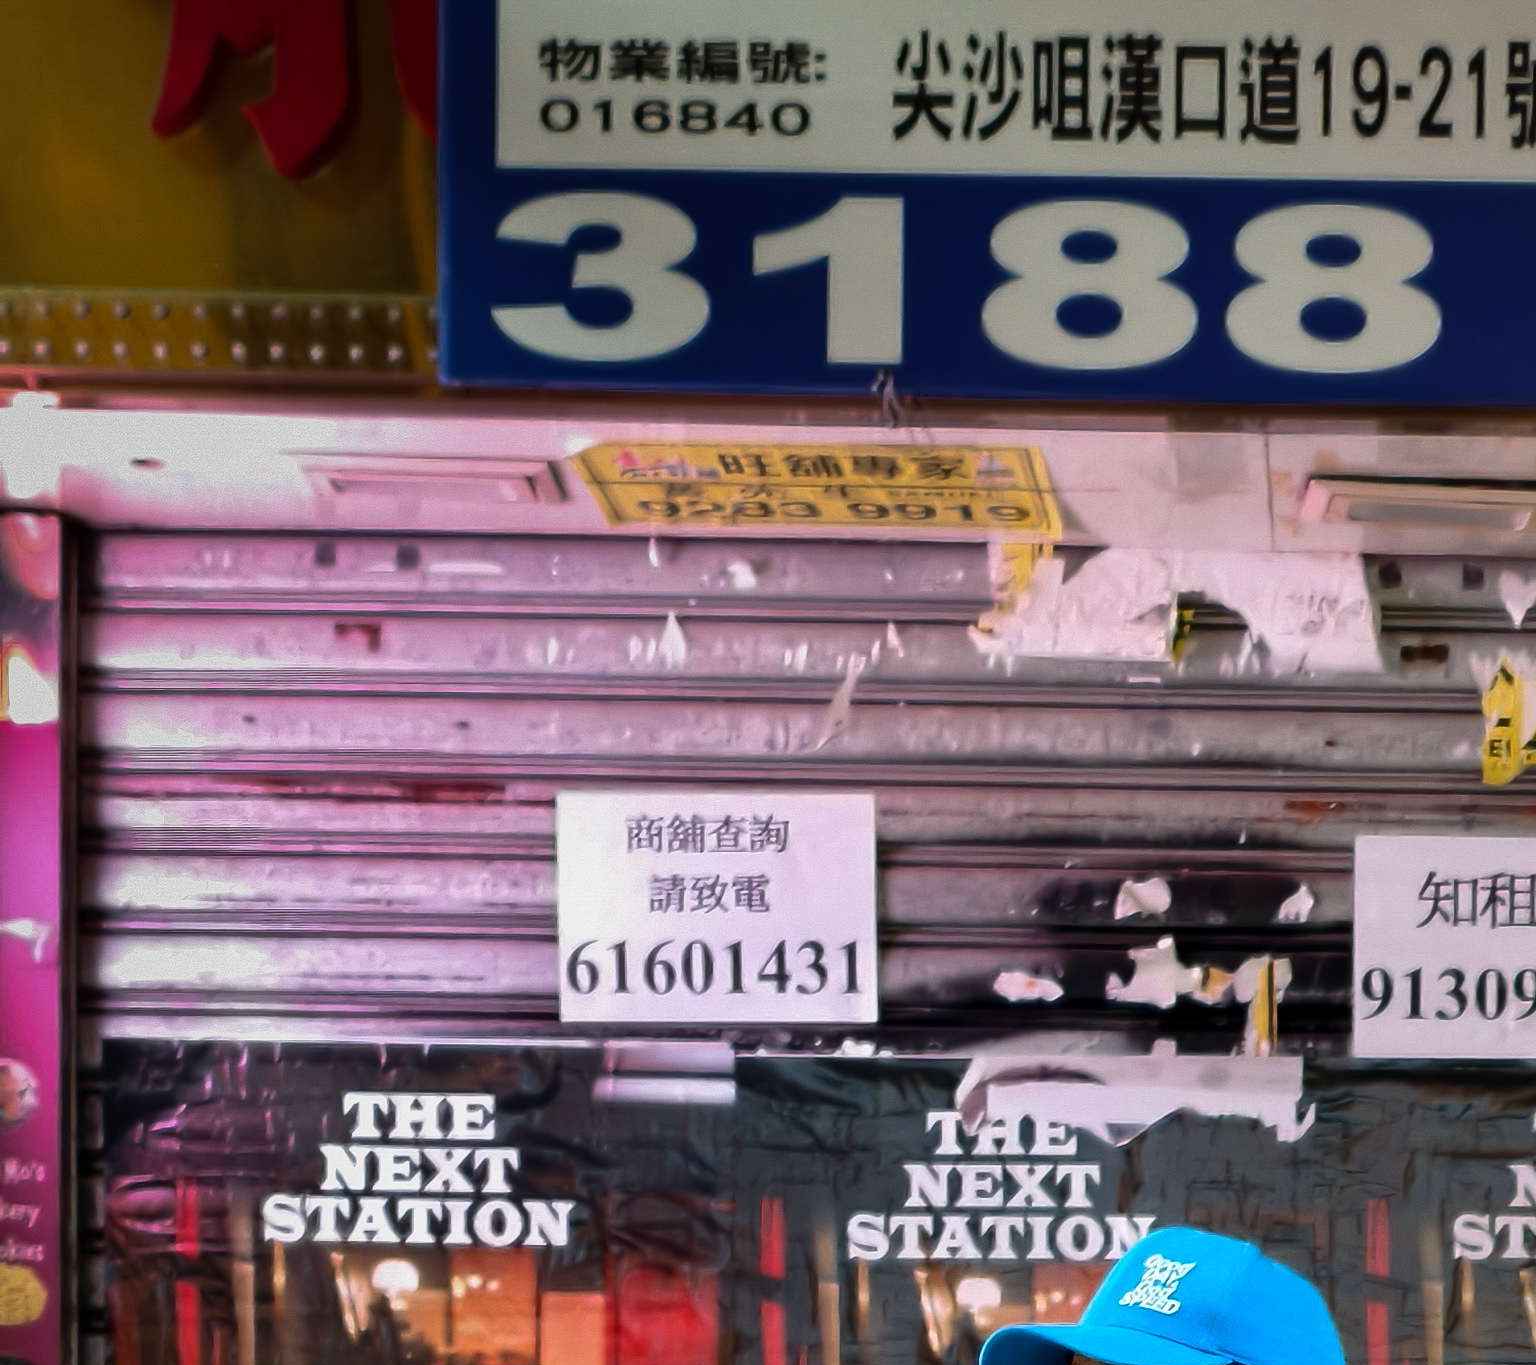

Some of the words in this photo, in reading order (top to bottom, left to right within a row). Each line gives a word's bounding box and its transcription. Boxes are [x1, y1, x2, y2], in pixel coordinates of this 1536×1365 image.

[539, 39, 825, 85] 物業編號:
[540, 100, 811, 137] 016840
[490, 191, 1442, 373] 3188
[650, 874, 771, 914] 請致電
[566, 940, 861, 996] 61601431
[343, 1091, 496, 1140] THE
[926, 1111, 1078, 1156] THE
[319, 1144, 521, 1193] NEXT
[902, 1164, 1100, 1208] NEXT
[261, 1193, 576, 1247] STATION
